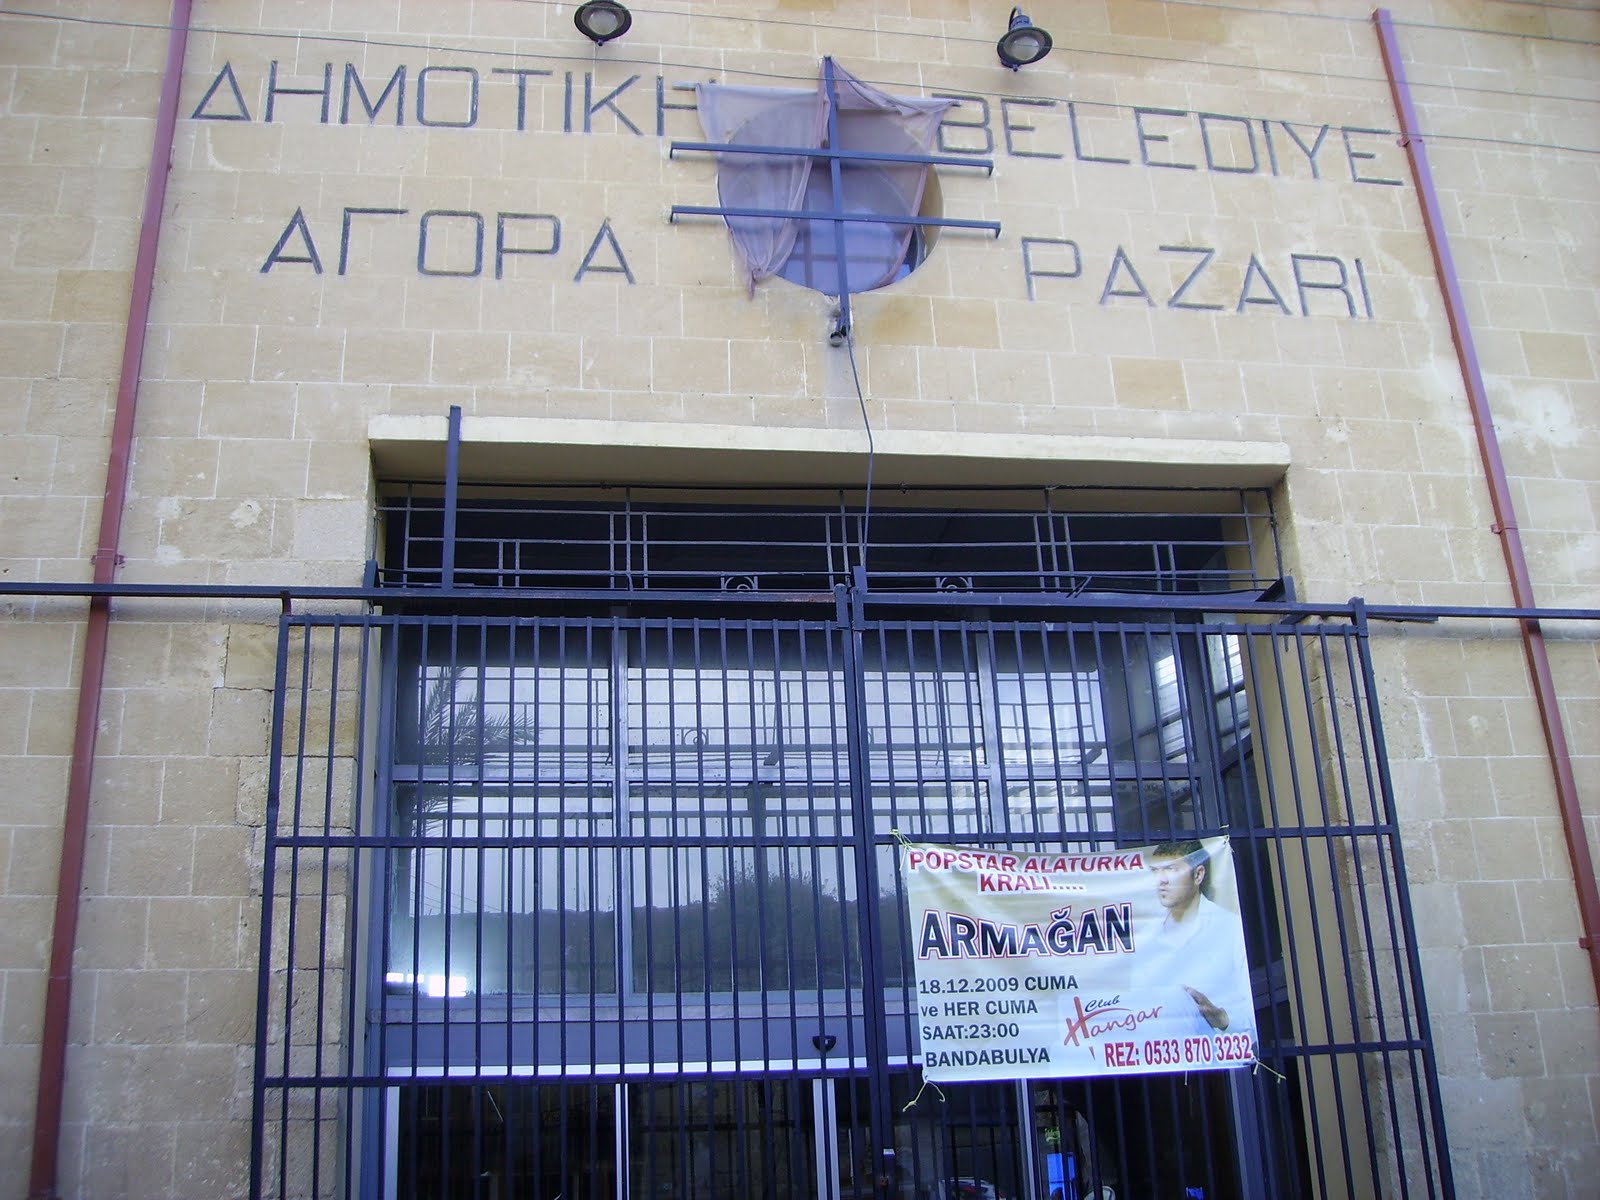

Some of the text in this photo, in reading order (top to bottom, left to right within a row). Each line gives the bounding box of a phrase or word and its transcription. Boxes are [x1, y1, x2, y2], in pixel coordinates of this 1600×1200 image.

[931, 93, 1404, 186] BELEDIYE
[260, 206, 636, 284] ΑΓΟΡΑ
[1021, 236, 1374, 319] PAZARI
[909, 851, 1144, 873] POPSTAR ALATURKA
[919, 903, 1136, 959] ARMAĞAN
[919, 975, 1079, 994] 18.12.2009 CUMA
[921, 1000, 1038, 1017] ve HER CUMA
[1084, 995, 1120, 1013] Club
[922, 1023, 1020, 1040] SAAT:23:00
[1063, 996, 1163, 1047] Hangar
[925, 1047, 1051, 1067] BANDABULYA
[1104, 1034, 1251, 1067] REZ: 0533 870 3232
